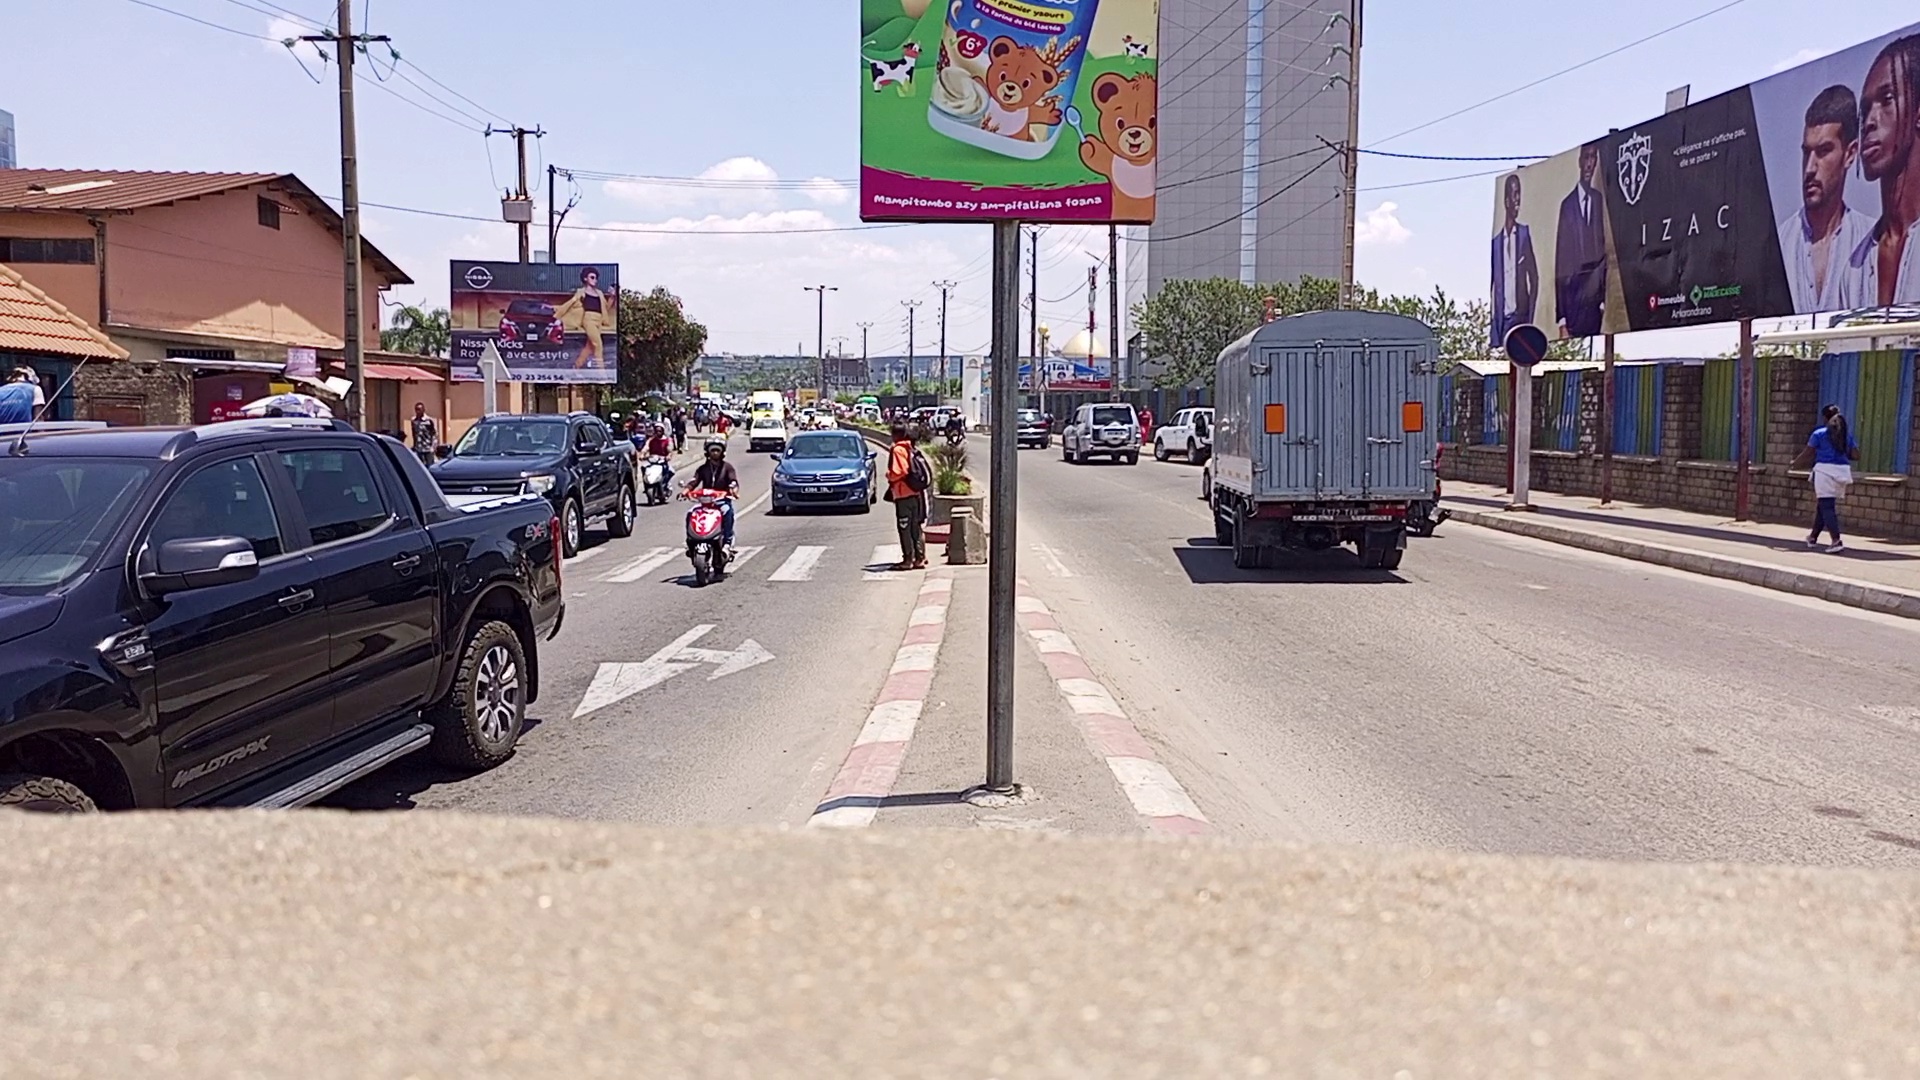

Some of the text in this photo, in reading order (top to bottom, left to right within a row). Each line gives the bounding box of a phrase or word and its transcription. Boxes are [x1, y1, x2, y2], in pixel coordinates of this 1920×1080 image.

[998, 1, 1064, 19] premier yaourt
[965, 37, 982, 51] 6+
[874, 194, 952, 208] Mampitombo
[956, 201, 978, 211] azy
[1065, 196, 1102, 207] foana
[1642, 204, 1730, 245] IZAC
[1657, 294, 1685, 305] Immeuble
[496, 340, 524, 349] Kicks
[506, 351, 537, 359] avec
[539, 350, 570, 360] style
[525, 373, 536, 381] 23
[171, 735, 272, 789] WILDTRAK
